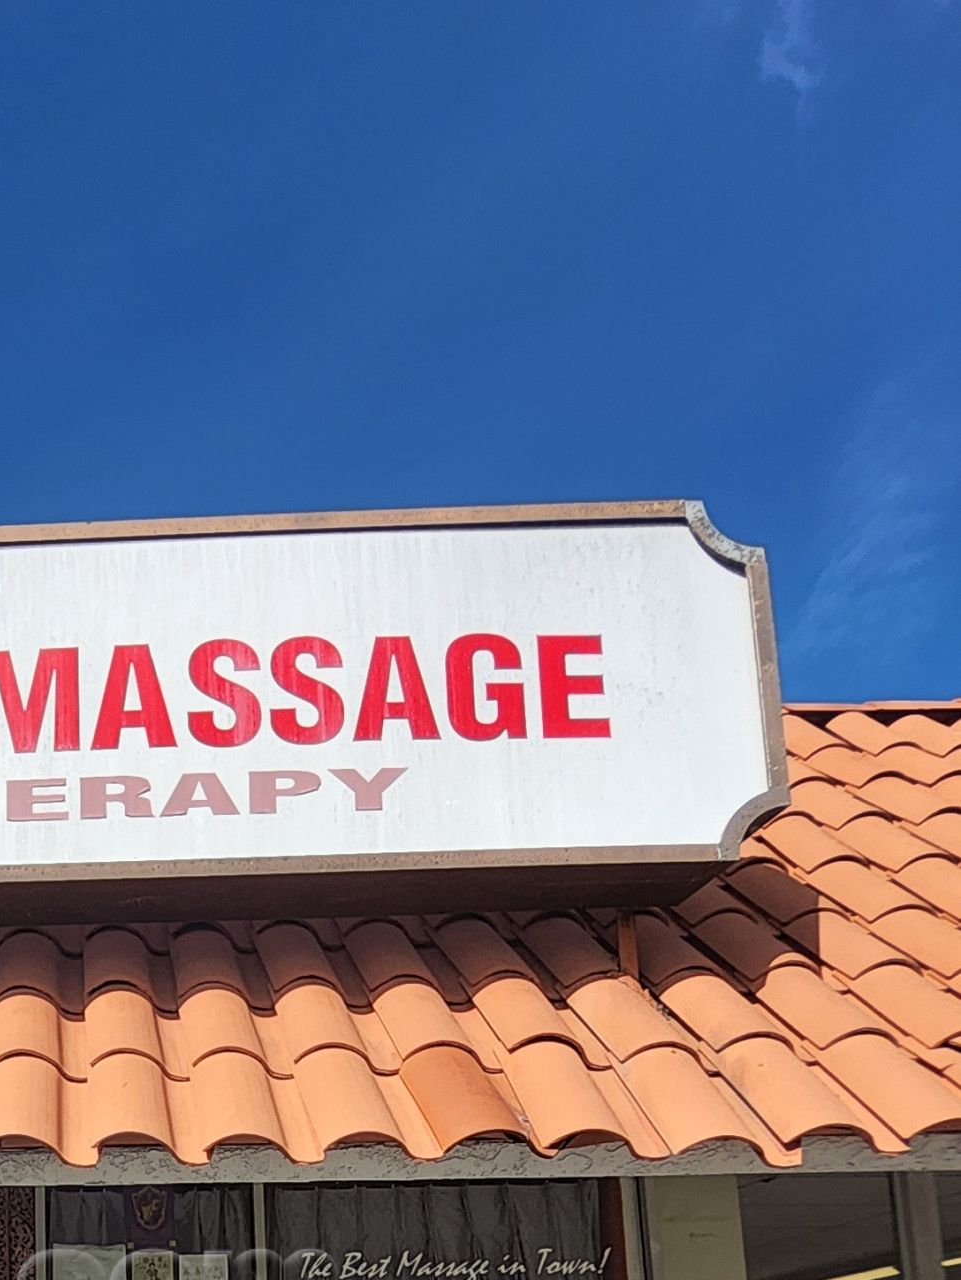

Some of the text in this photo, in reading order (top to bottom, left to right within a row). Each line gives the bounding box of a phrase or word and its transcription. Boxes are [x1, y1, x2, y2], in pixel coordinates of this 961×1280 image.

[300, 1251, 331, 1278] The
[339, 1252, 390, 1279] Best
[497, 1255, 526, 1275] in
[538, 1247, 613, 1275] Town!
